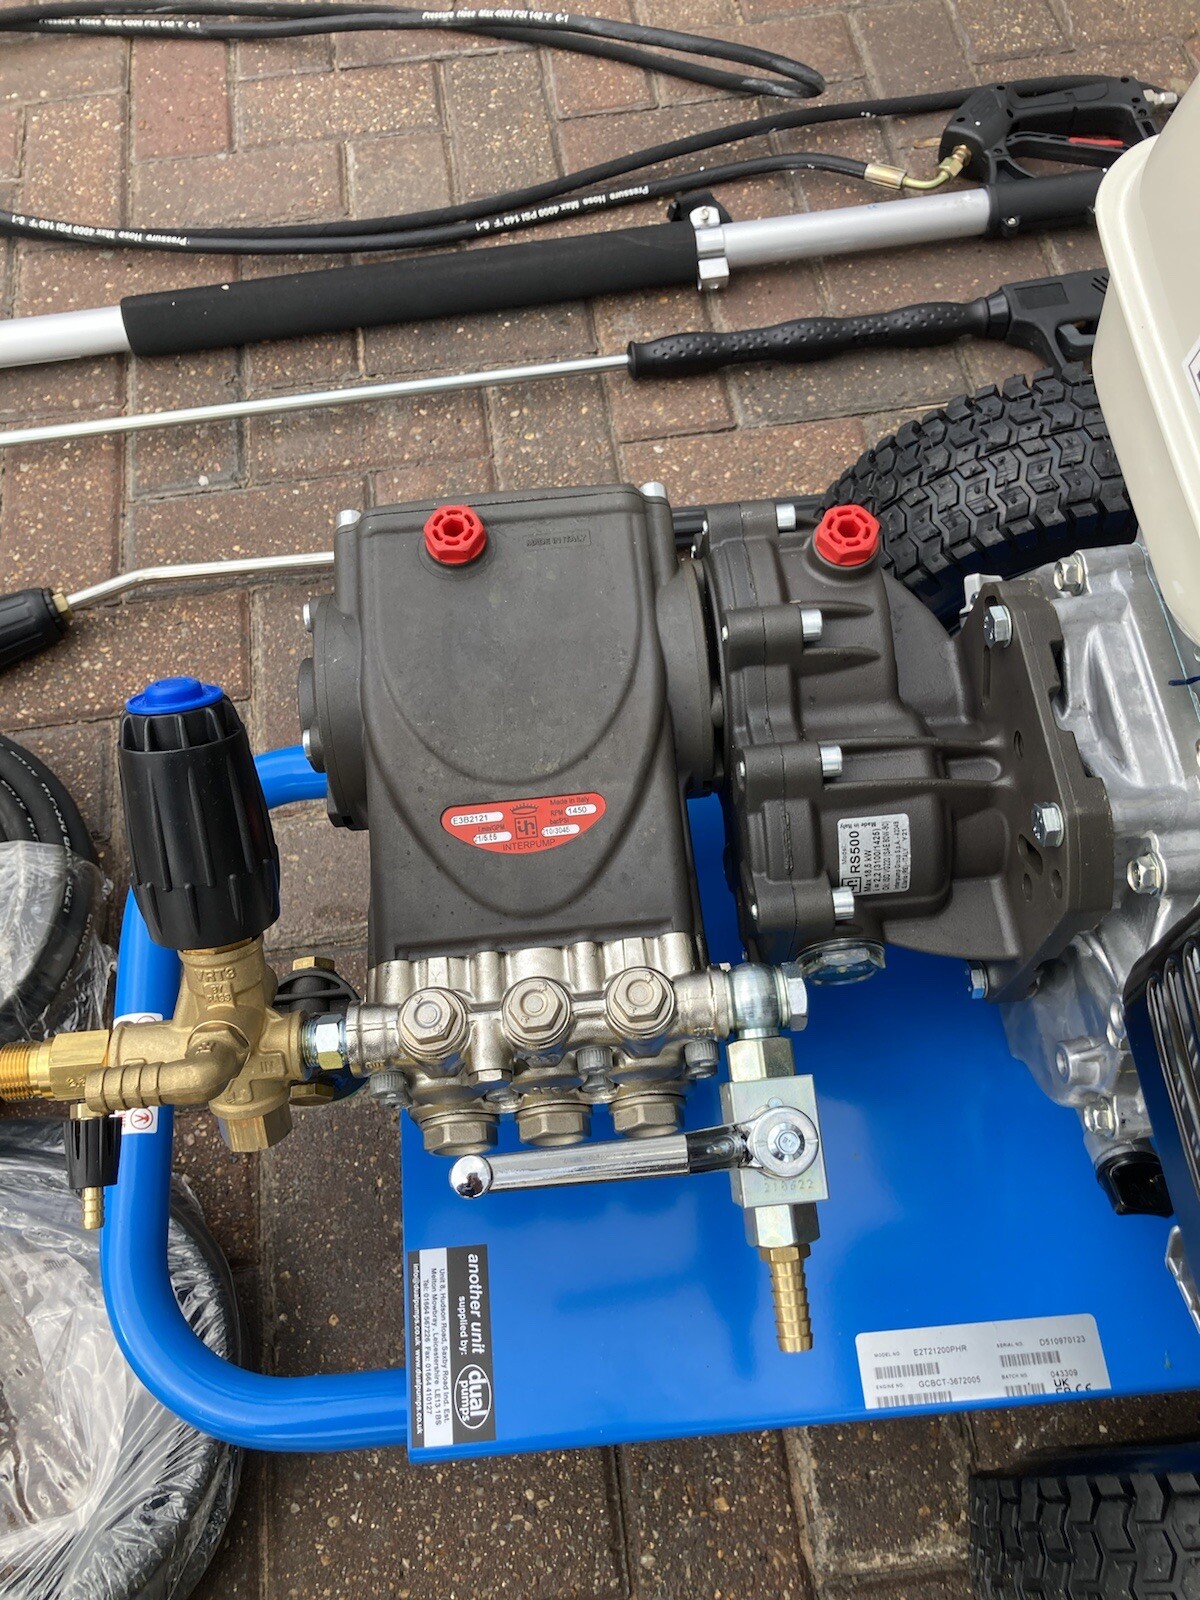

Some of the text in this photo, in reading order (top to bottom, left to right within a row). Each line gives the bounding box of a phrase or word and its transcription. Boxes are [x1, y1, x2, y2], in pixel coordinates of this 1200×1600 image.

[422, 11, 454, 20] Pressure
[456, 10, 476, 18] Hose
[478, 9, 493, 18] Max
[494, 9, 512, 18] 4000
[513, 10, 528, 18] PSI
[529, 11, 543, 20] 140
[555, 13, 569, 22] 6-1
[610, 186, 650, 200] Pressure
[560, 200, 580, 212] Max
[582, 195, 606, 206] Hose
[521, 210, 538, 222] PSI
[538, 205, 559, 218] 4000
[12, 214, 26, 225] 6-1
[38, 219, 54, 230] 140
[504, 214, 520, 226] 140
[56, 221, 72, 234] PSI
[72, 226, 95, 236] 4000
[475, 220, 490, 232] 6-1
[96, 228, 116, 240] Max
[118, 230, 142, 242] Hose
[145, 233, 188, 246] Pressure
[576, 796, 590, 804] Italy
[568, 806, 587, 814] 1450
[453, 815, 488, 824] E3B2121
[502, 838, 556, 851] INTERPUMP
[872, 828, 882, 870] (3100/1425)
[848, 830, 860, 874] RS500
[864, 850, 872, 861] kW
[874, 872, 882, 882] 2,2
[864, 876, 872, 892] Max
[260, 1061, 276, 1074] IN
[468, 1254, 486, 1354] another unit
[457, 1296, 468, 1356] supplied by:
[1039, 1335, 1086, 1347] D510970123
[412, 1264, 423, 1434] info@dualpumps.co.uk www.dualpumps.co.uk
[913, 1344, 968, 1356] E2T21200PHR
[432, 1333, 440, 1385] Leicestershire
[441, 1346, 449, 1368] Saxby
[1050, 1369, 1078, 1378] 043309
[918, 1376, 981, 1388] GCBCT-3672005
[1054, 1378, 1069, 1388] UK
[468, 1370, 488, 1417] dual
[458, 1380, 470, 1422] pumps
